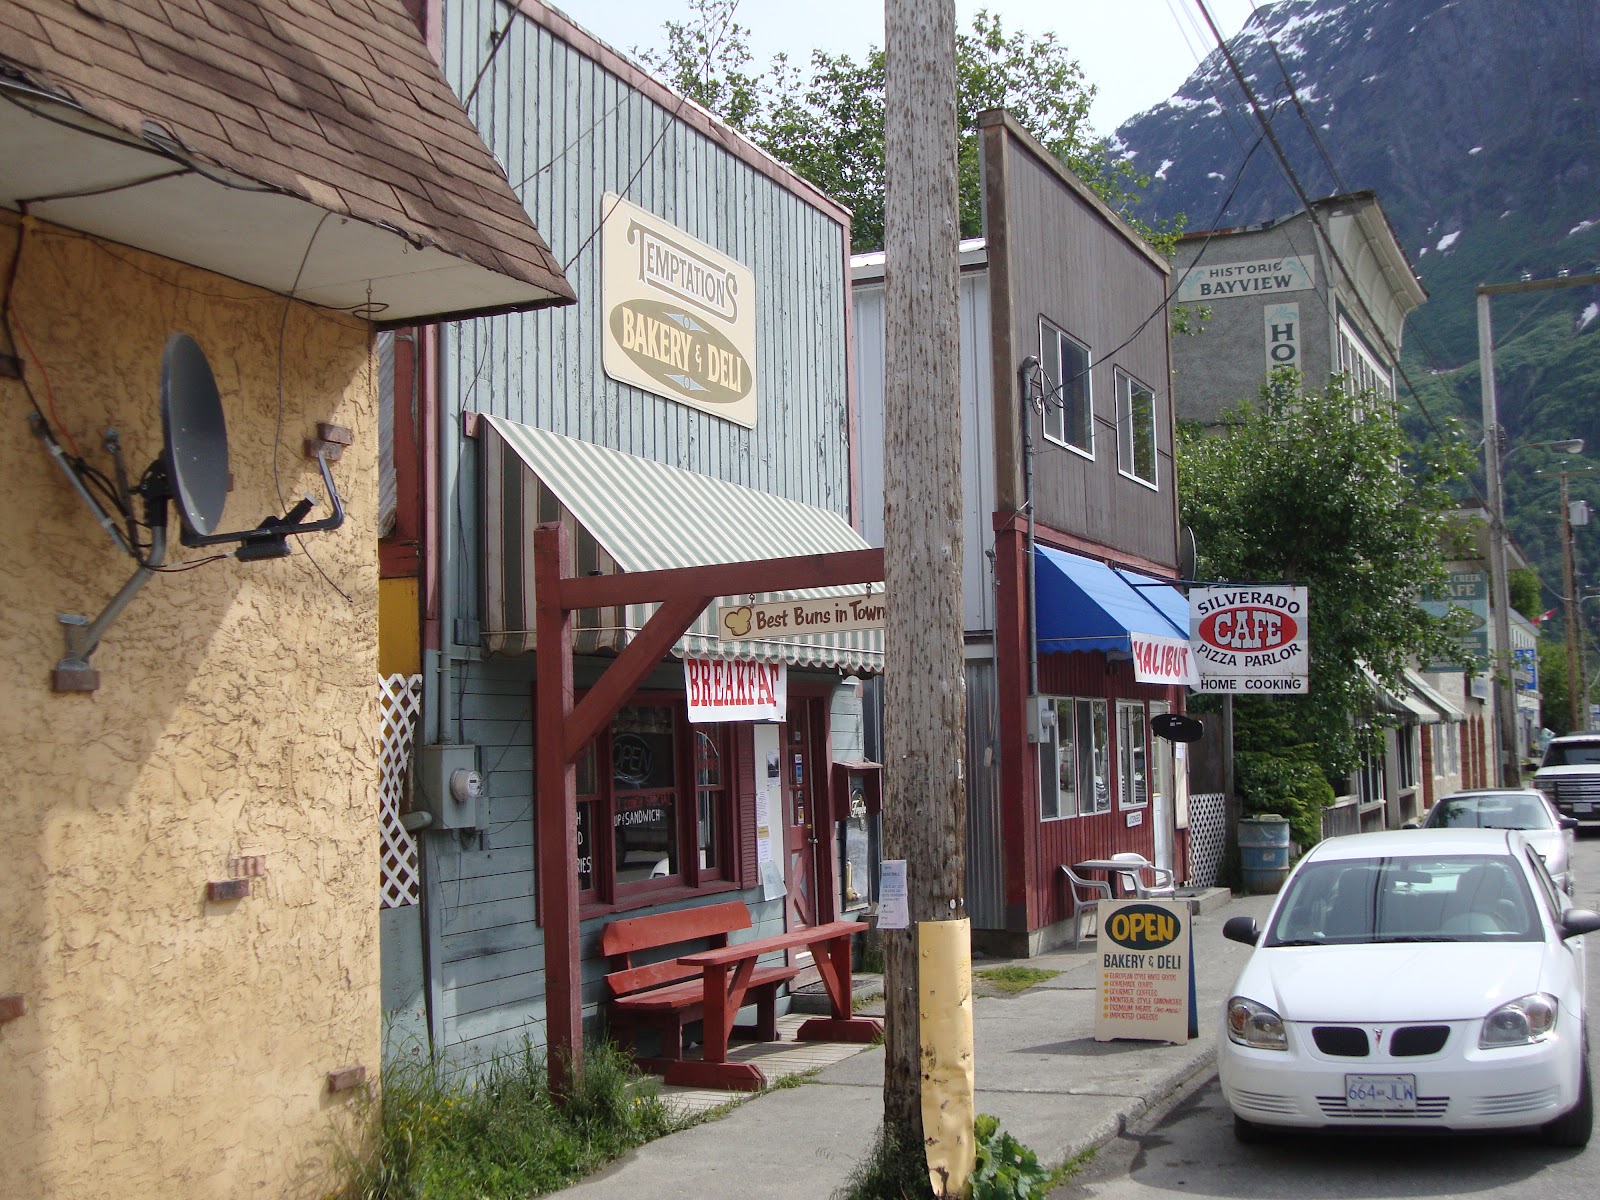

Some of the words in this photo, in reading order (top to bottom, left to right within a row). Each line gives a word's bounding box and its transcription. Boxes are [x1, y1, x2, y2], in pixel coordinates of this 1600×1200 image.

[626, 217, 738, 324] TEMPTATIONS
[1209, 262, 1282, 278] HISTORIC
[1200, 274, 1292, 296] BAYVIEW
[622, 307, 692, 372] BAKERY
[695, 345, 702, 372] &
[707, 343, 742, 393] DELI
[1454, 574, 1481, 582] CREEK
[1446, 584, 1476, 596] AFE
[1197, 591, 1300, 615] SILVERADO
[756, 610, 788, 630] Best
[794, 607, 830, 625] Buns
[835, 603, 847, 622] in
[850, 600, 886, 621] Town
[1214, 610, 1282, 649] CAFE
[1197, 644, 1237, 666] PIZZA
[1244, 643, 1302, 667] PARLOR
[1201, 679, 1237, 690] HOME
[1245, 679, 1301, 690] COOKING
[614, 814, 622, 826] UP
[625, 809, 660, 825] SANDWICH
[1111, 913, 1174, 942] OPEN
[1104, 954, 1145, 969] BAKERY
[1149, 956, 1153, 968] &
[1158, 955, 1181, 969] DELI
[1349, 1084, 1375, 1100] 664
